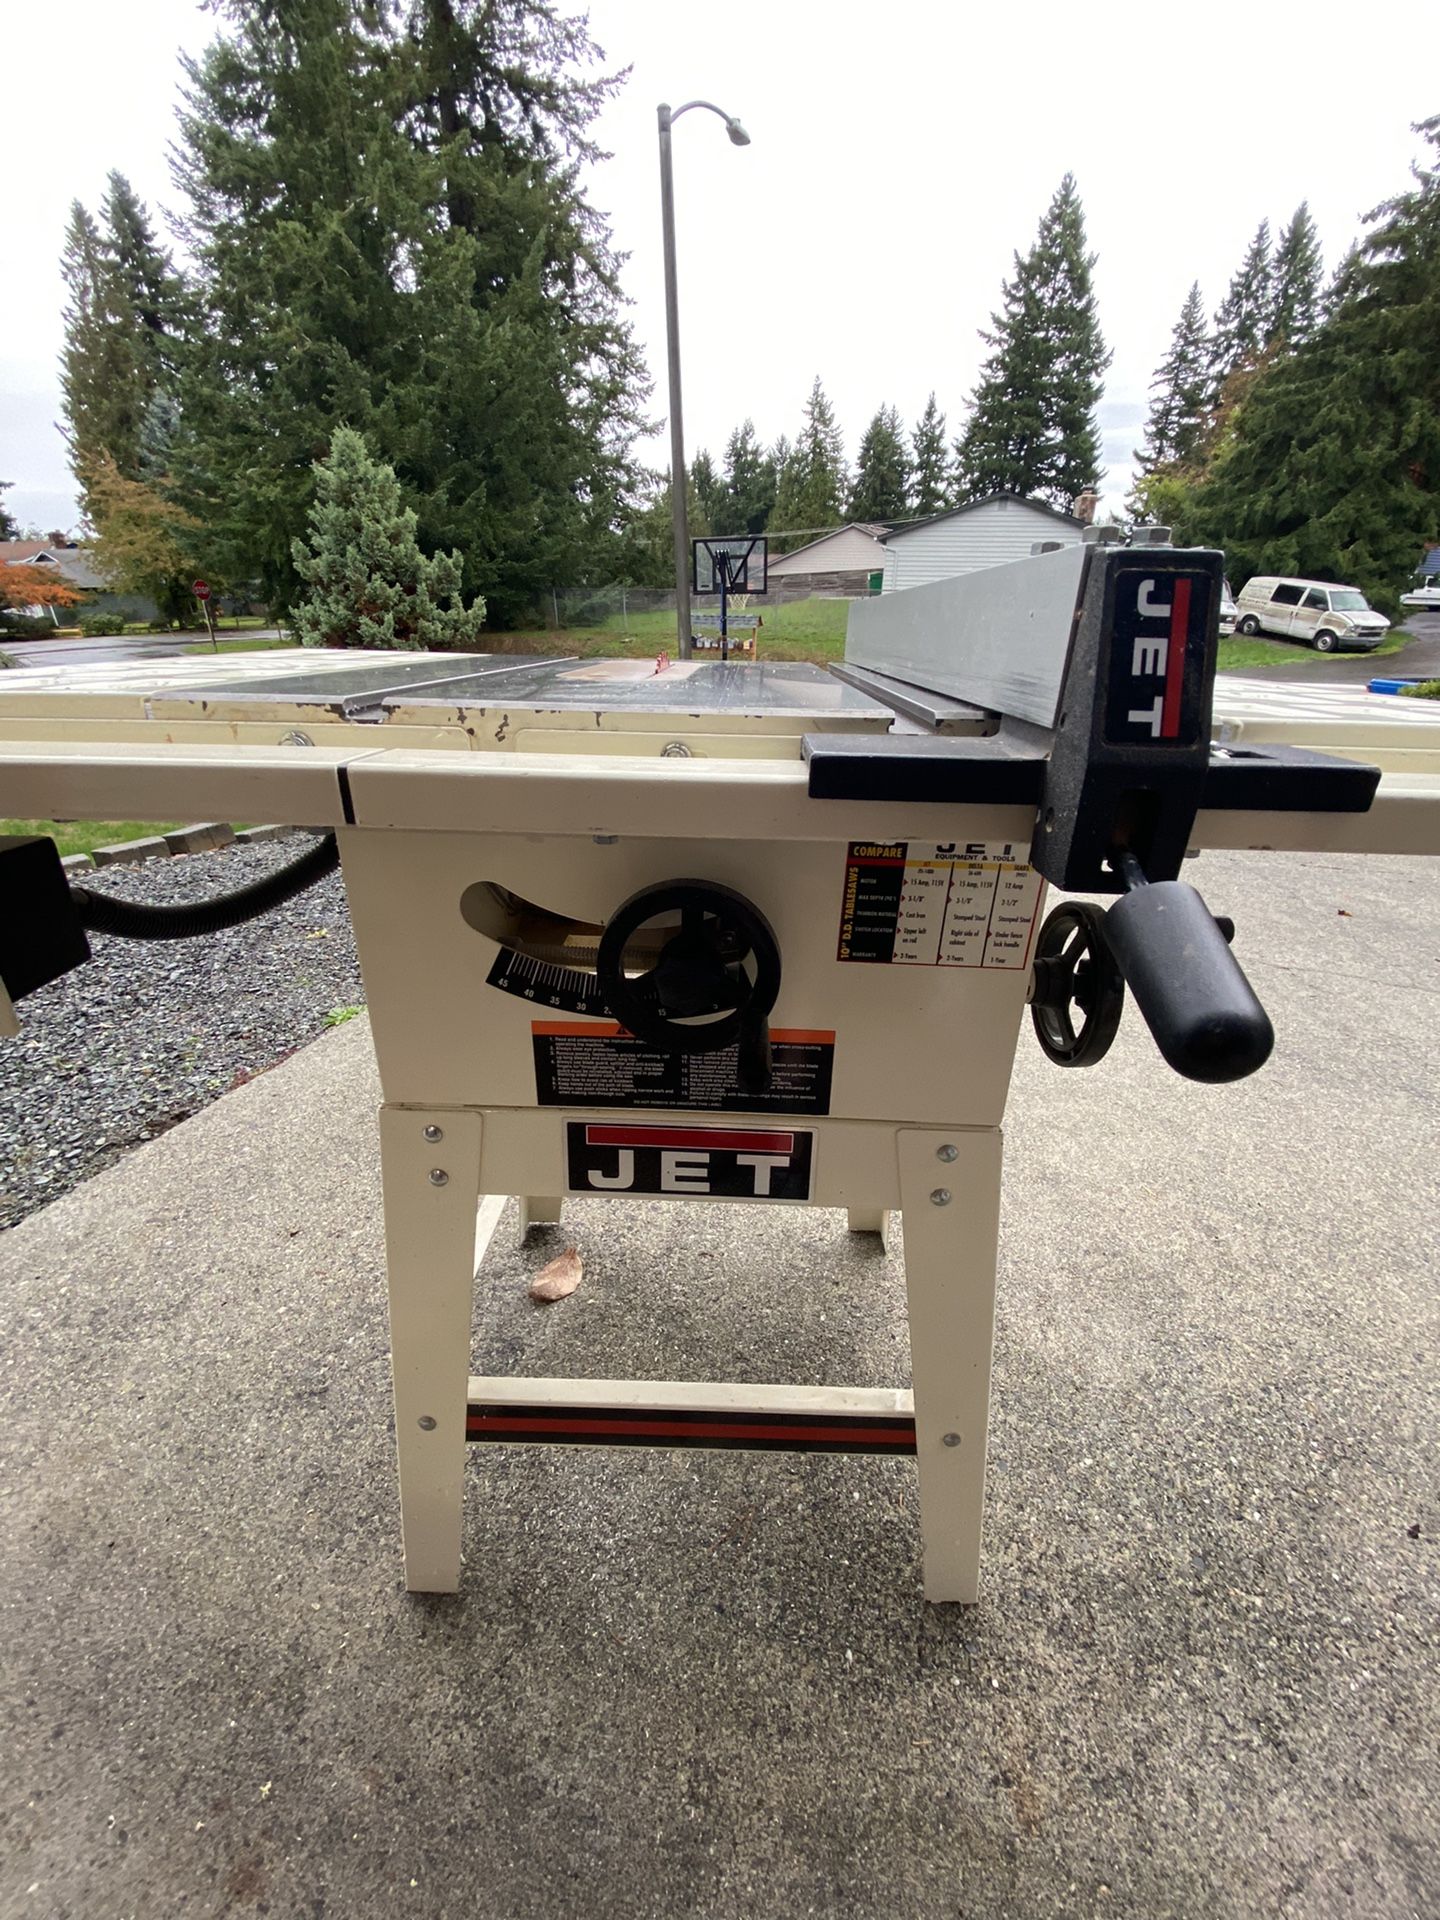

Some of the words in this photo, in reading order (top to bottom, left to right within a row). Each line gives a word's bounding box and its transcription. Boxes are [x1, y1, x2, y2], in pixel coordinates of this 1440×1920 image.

[1127, 579, 1172, 737] JET
[853, 846, 903, 858] COMPARE
[935, 853, 979, 861] EQUIPMENT
[844, 866, 860, 920] TABLESAWS
[498, 977, 509, 988] 45
[523, 988, 535, 999] 40
[549, 995, 561, 1006] 35
[575, 1001, 587, 1011] 30
[587, 1149, 791, 1195] JET
